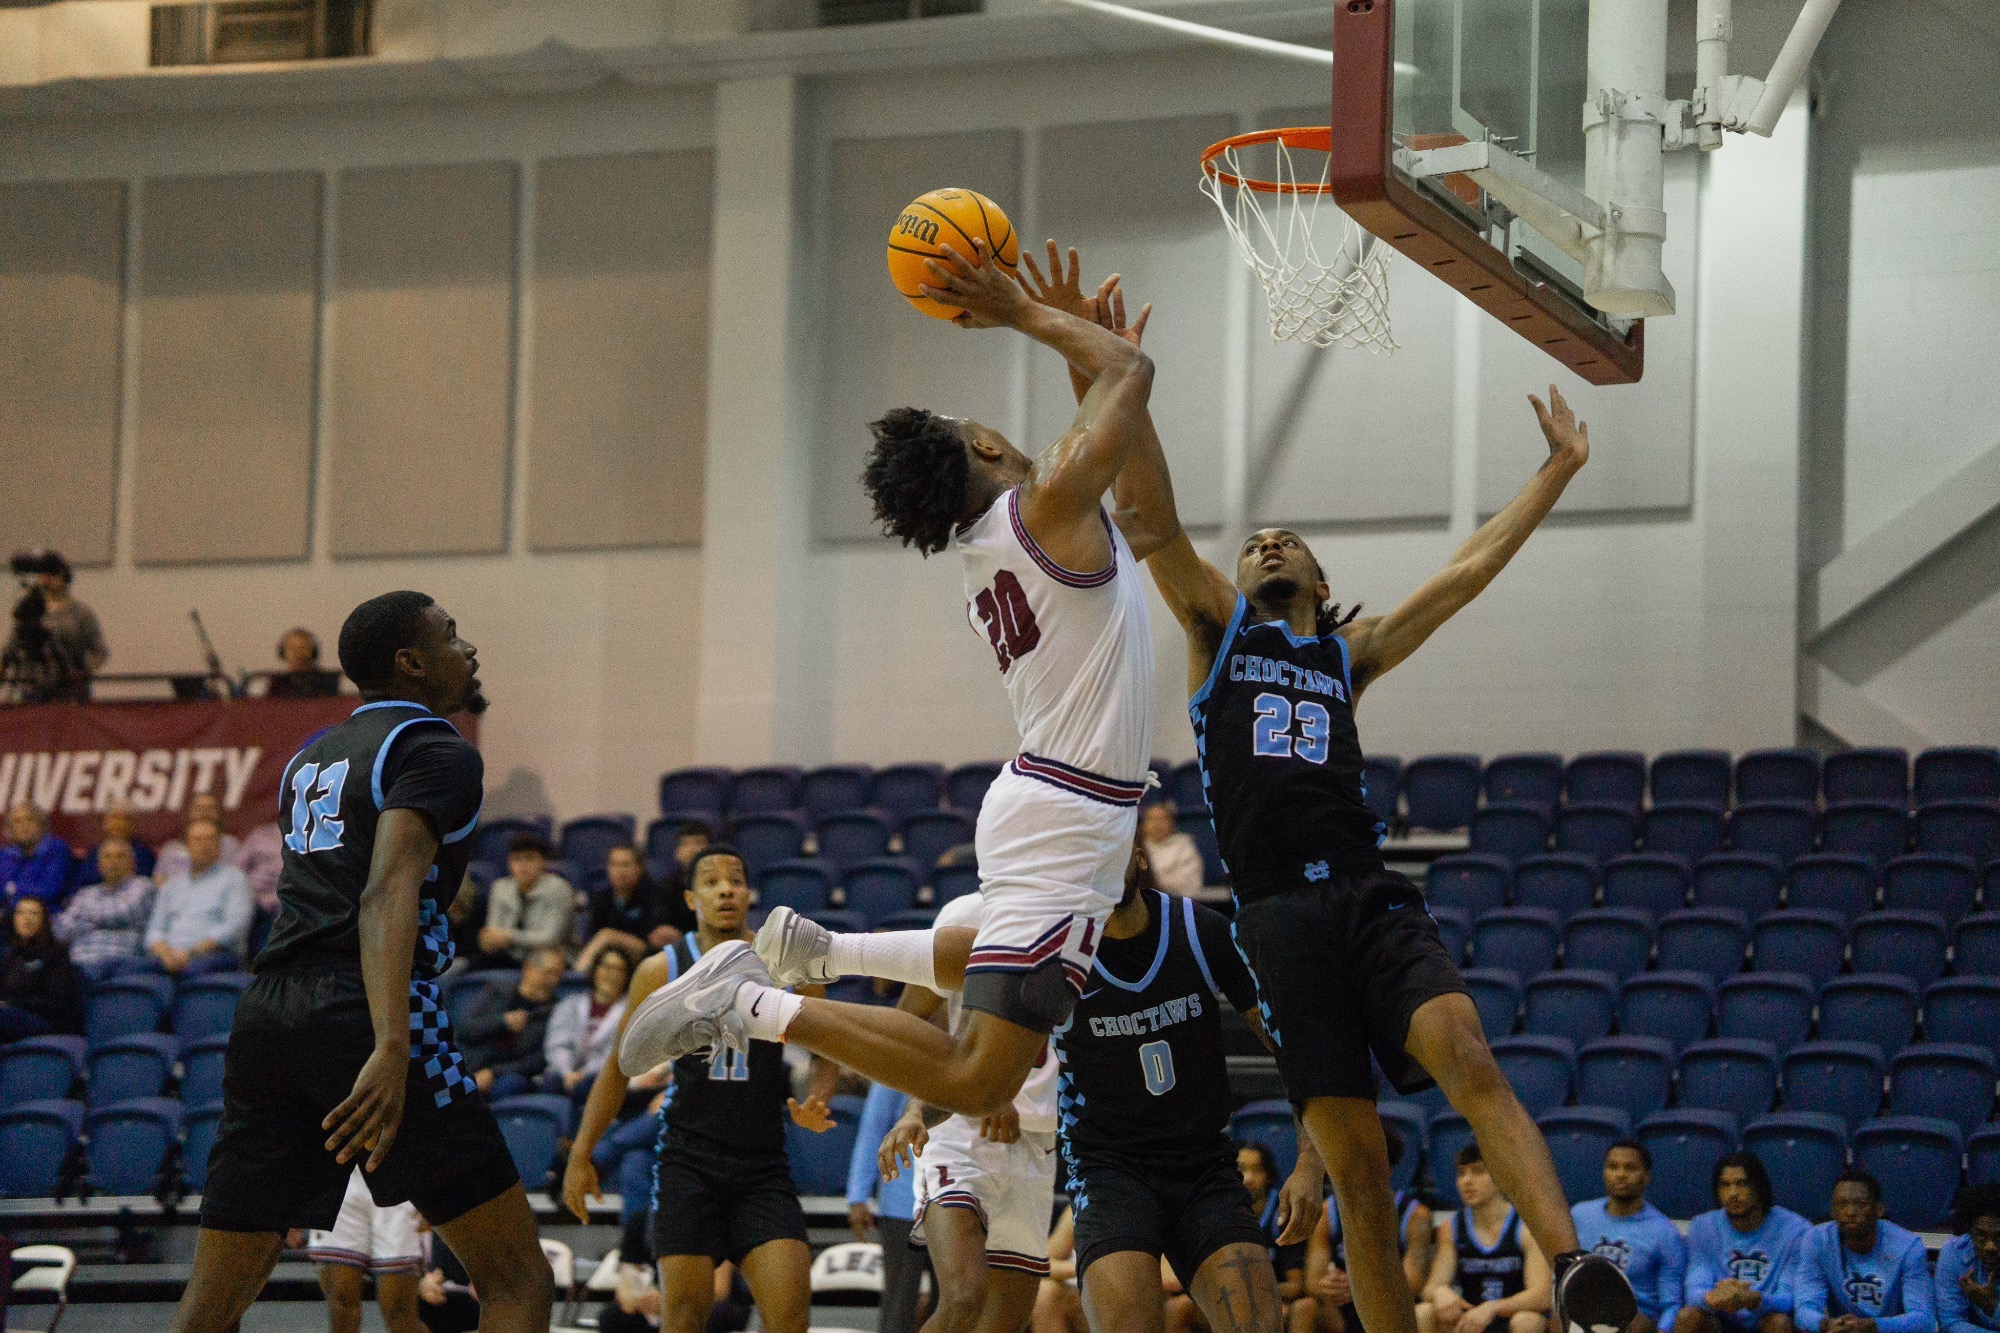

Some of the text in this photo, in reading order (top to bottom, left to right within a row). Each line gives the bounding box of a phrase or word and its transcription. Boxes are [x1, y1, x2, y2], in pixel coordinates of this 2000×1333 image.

[1229, 654, 1347, 703] CHOCTAWS
[1253, 692, 1331, 765] 23
[284, 757, 350, 855] 12
[1088, 993, 1203, 1037] CHOCTAWS
[1138, 1039, 1177, 1096] 0
[935, 1165, 956, 1188] L
